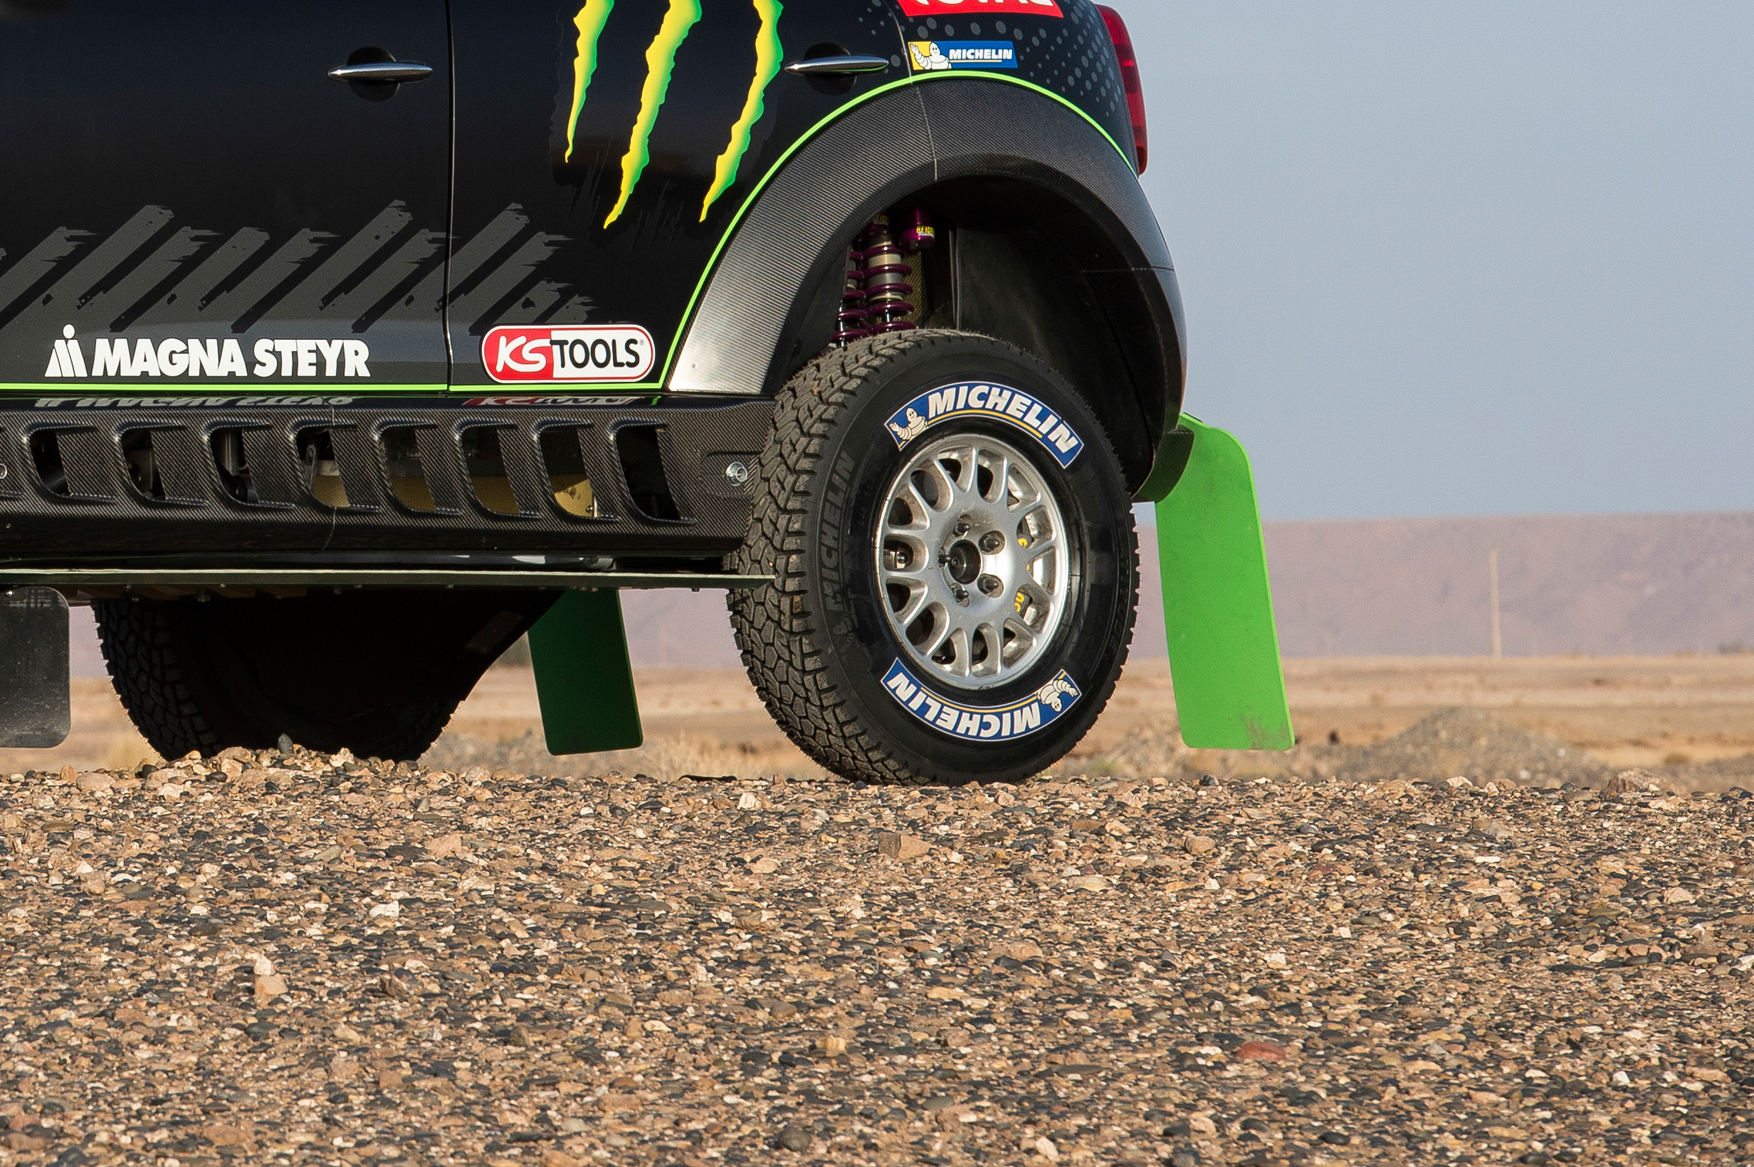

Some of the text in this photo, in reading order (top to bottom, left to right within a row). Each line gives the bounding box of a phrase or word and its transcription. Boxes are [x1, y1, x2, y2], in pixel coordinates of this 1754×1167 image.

[948, 48, 1013, 60] MICHELIN
[91, 337, 371, 378] MAGNA STEYR
[928, 384, 1077, 459] MICHELIN
[820, 448, 857, 612] MICHELIN
[887, 671, 1042, 738] MICHELIN
